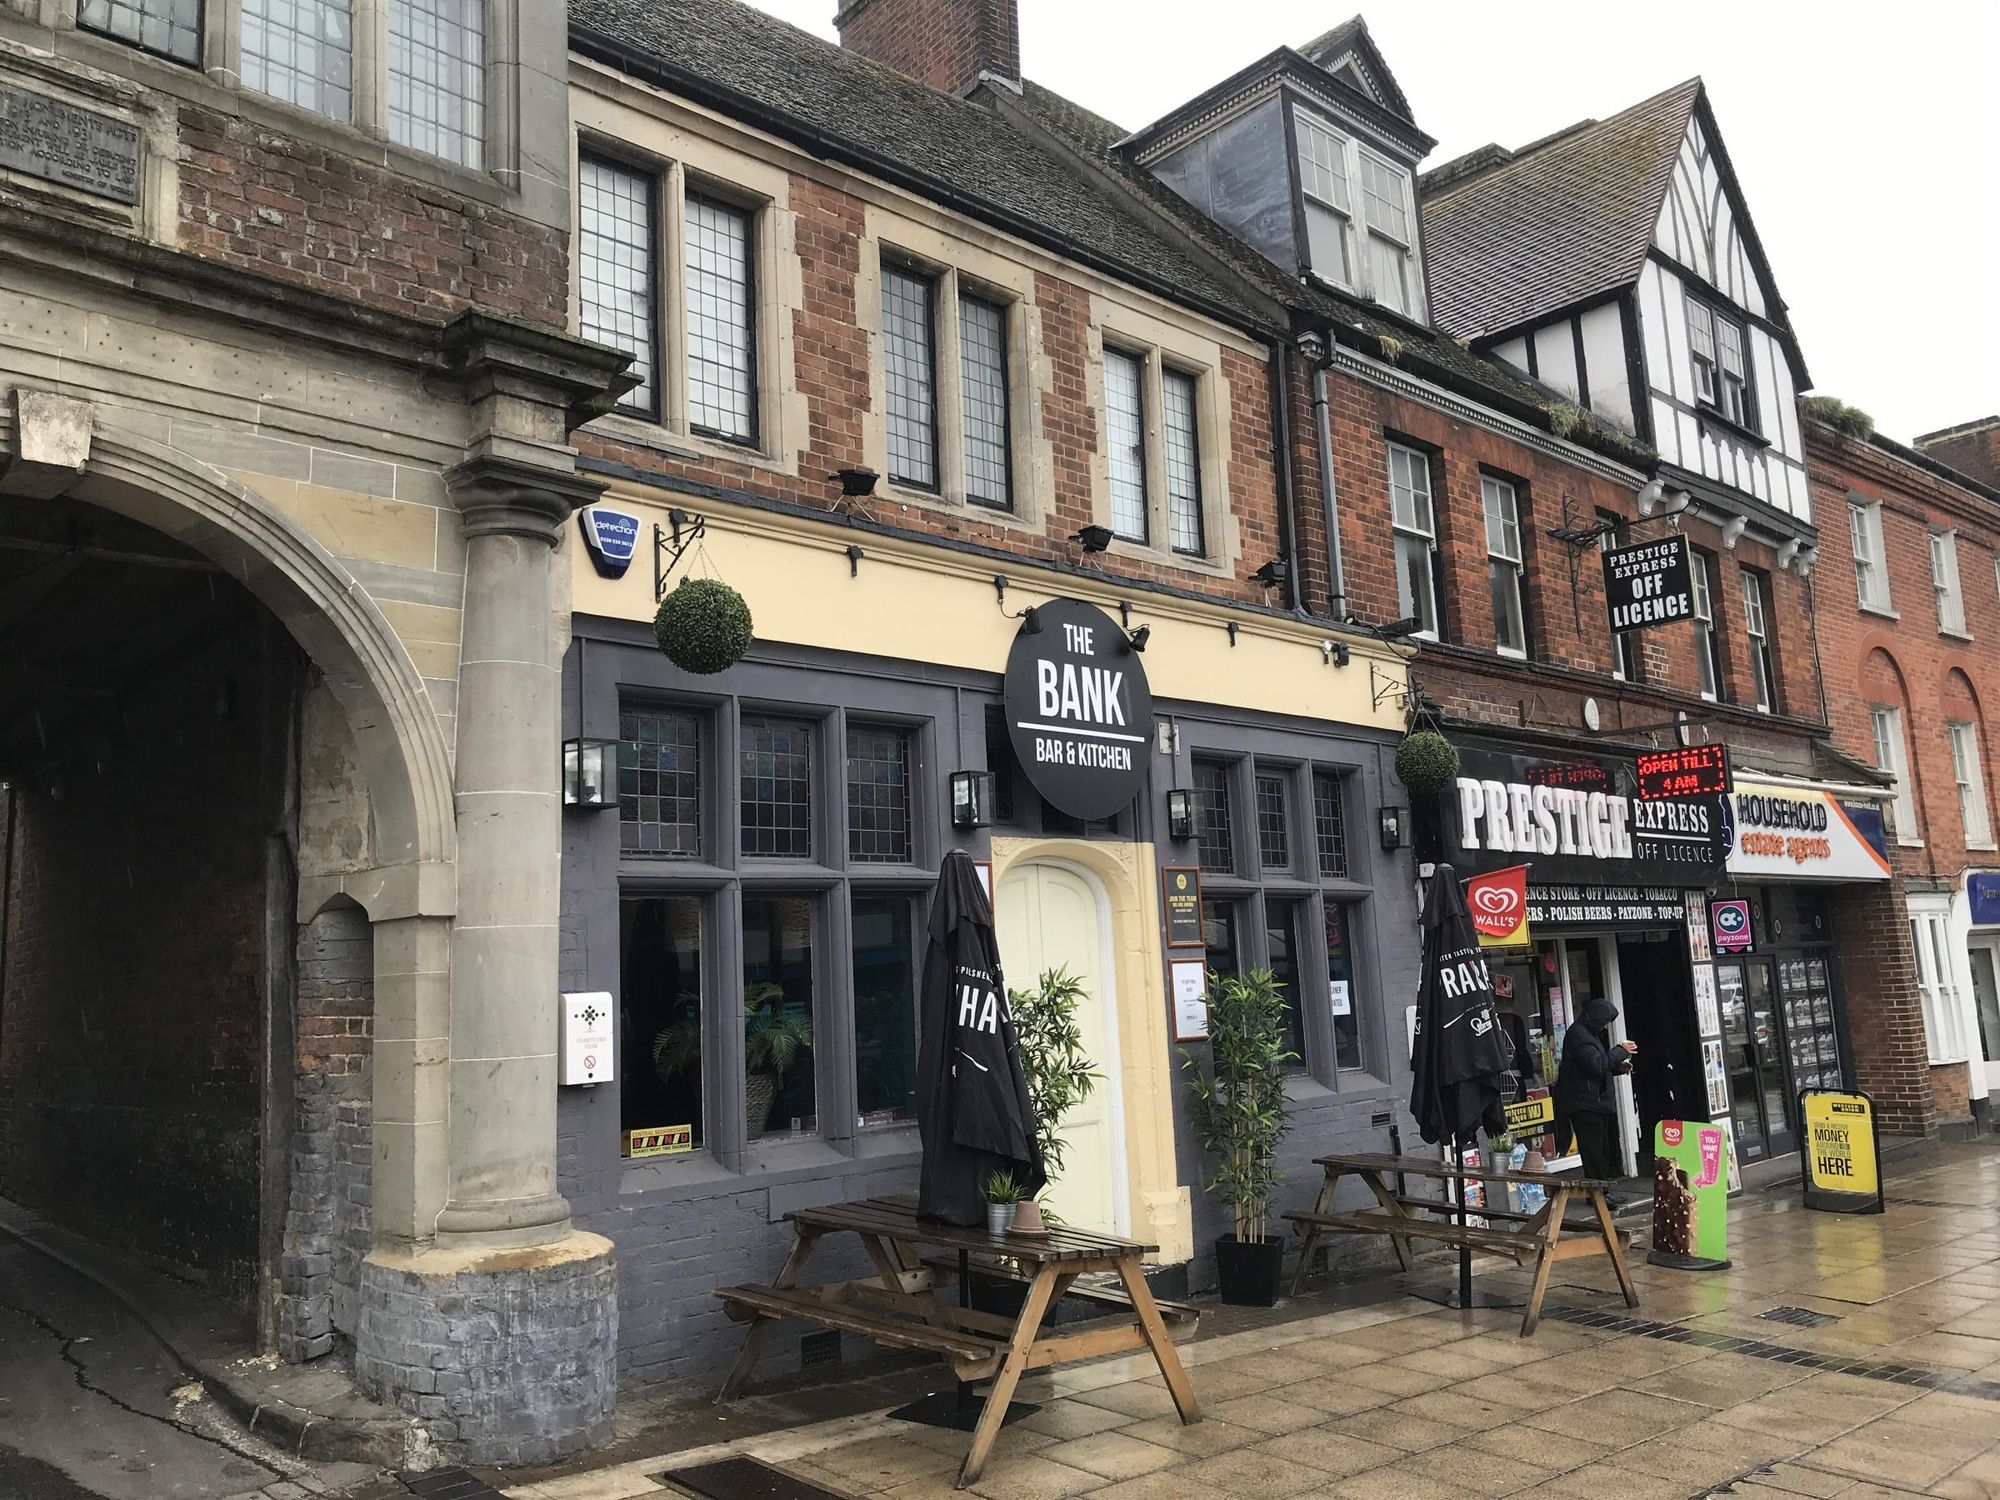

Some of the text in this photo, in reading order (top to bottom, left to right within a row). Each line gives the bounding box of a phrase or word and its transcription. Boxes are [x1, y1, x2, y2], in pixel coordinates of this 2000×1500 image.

[596, 521, 637, 536] detection
[1609, 542, 1679, 567] PRESTIGE
[1615, 556, 1677, 579] EXPRESS
[1632, 574, 1663, 599] OFF
[1613, 593, 1689, 627] LICENCE
[1063, 623, 1095, 656] THE
[1037, 659, 1126, 726] BANK
[1036, 738, 1132, 771] BAR & KITCHEN
[1642, 755, 1713, 775] OPEN TILL
[1663, 775, 1698, 790] 4 AM
[1456, 777, 1633, 859] PRESTIGE
[1633, 798, 1710, 834] EXPRESS
[1736, 793, 1828, 832] HOUSEHOLD
[1637, 842, 1714, 864] OFF LICENCE
[1741, 832, 1831, 865] estate agents
[1550, 887, 1580, 900] STORE
[1585, 887, 1602, 900] OFF
[1604, 888, 1639, 901] LICENCE
[1645, 888, 1678, 901] TOBACCO
[1475, 914, 1514, 928] WALL'S
[1551, 907, 1584, 921] POLISH
[1584, 907, 1613, 920] BEERS
[1618, 906, 1653, 920] PAYZONE
[1658, 906, 1684, 919] TOP-UP
[1717, 934, 1749, 944] payzone
[1705, 1136, 1716, 1144] YOU
[1814, 1129, 1849, 1143] MONEY
[1702, 1144, 1718, 1152] WANT
[1817, 1149, 1828, 1157] THE
[1818, 1156, 1854, 1177] HERE
